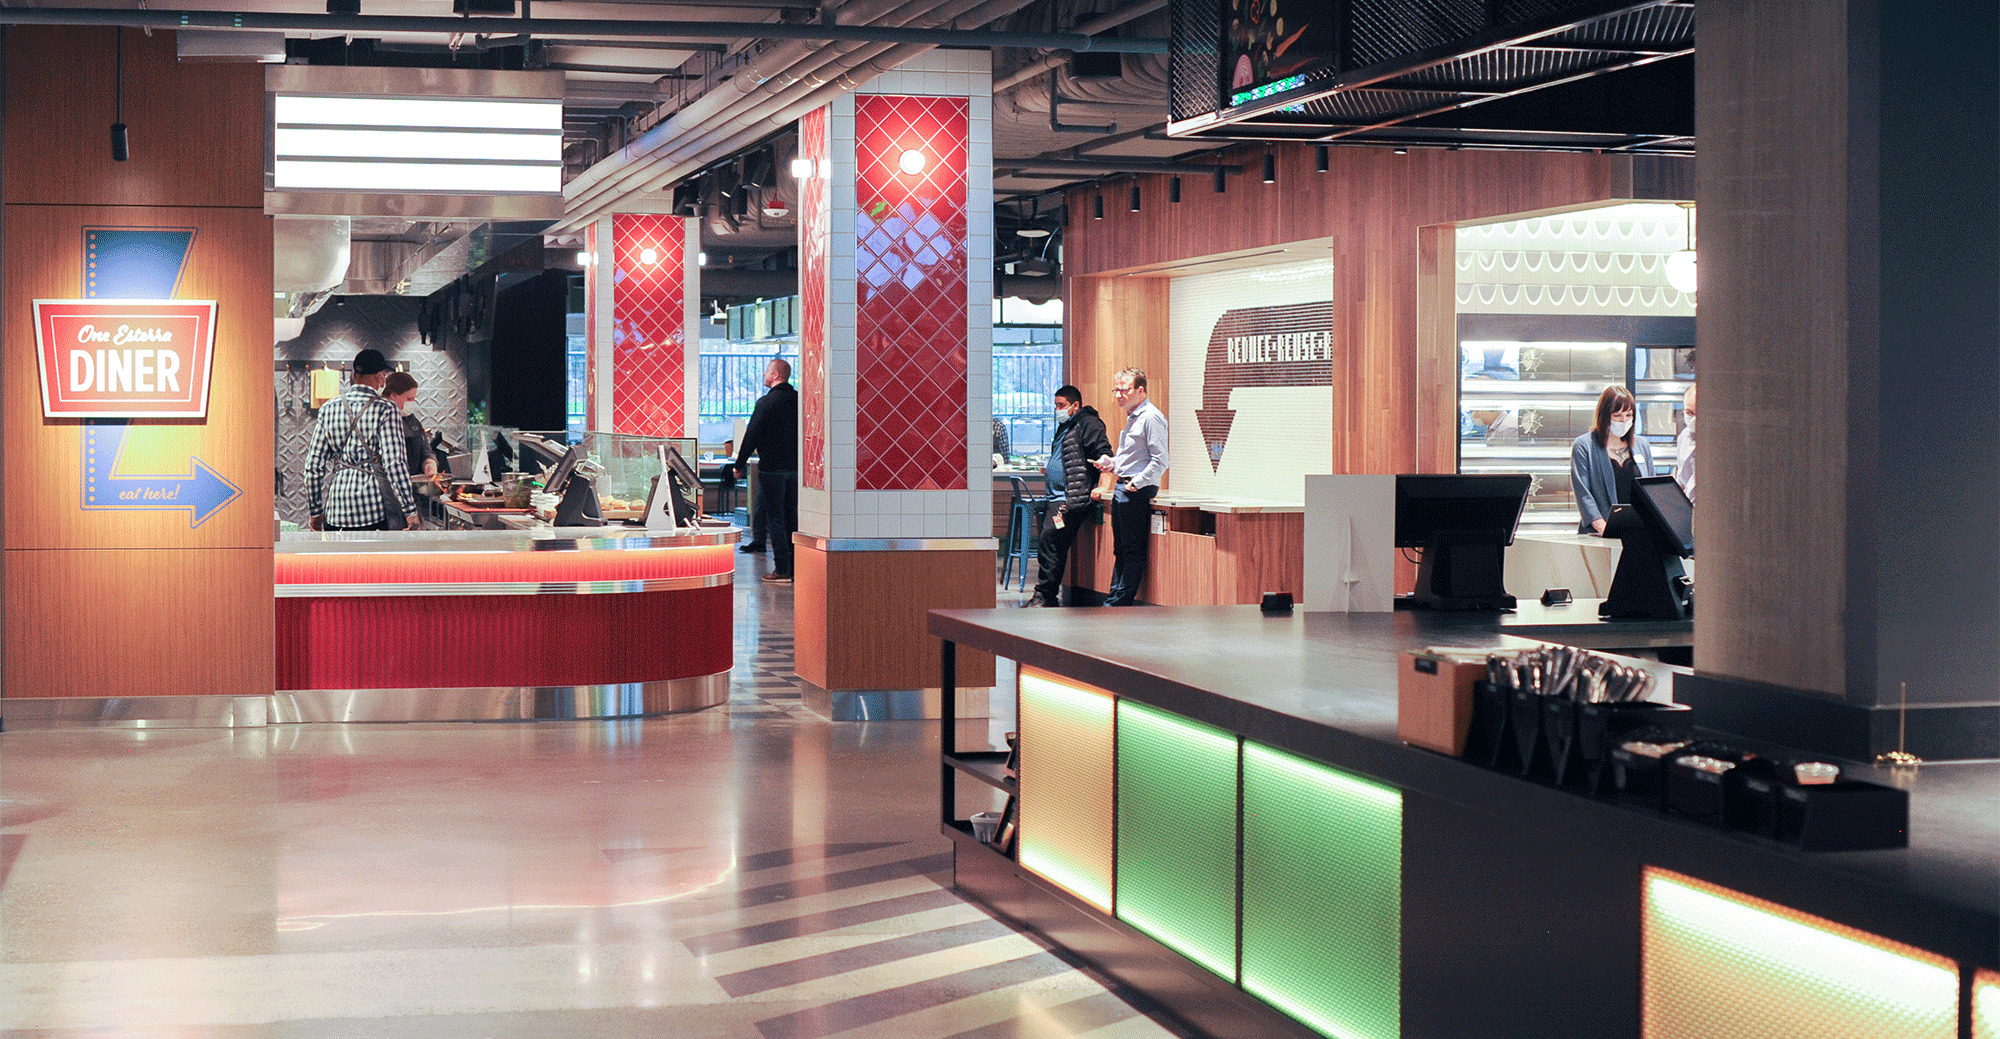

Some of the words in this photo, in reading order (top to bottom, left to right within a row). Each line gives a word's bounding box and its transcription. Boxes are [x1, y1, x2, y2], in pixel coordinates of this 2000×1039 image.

[77, 324, 111, 344] One
[112, 323, 173, 346] Esterra
[70, 349, 181, 393] DINER
[118, 487, 143, 500] eat
[143, 483, 181, 500] here!
